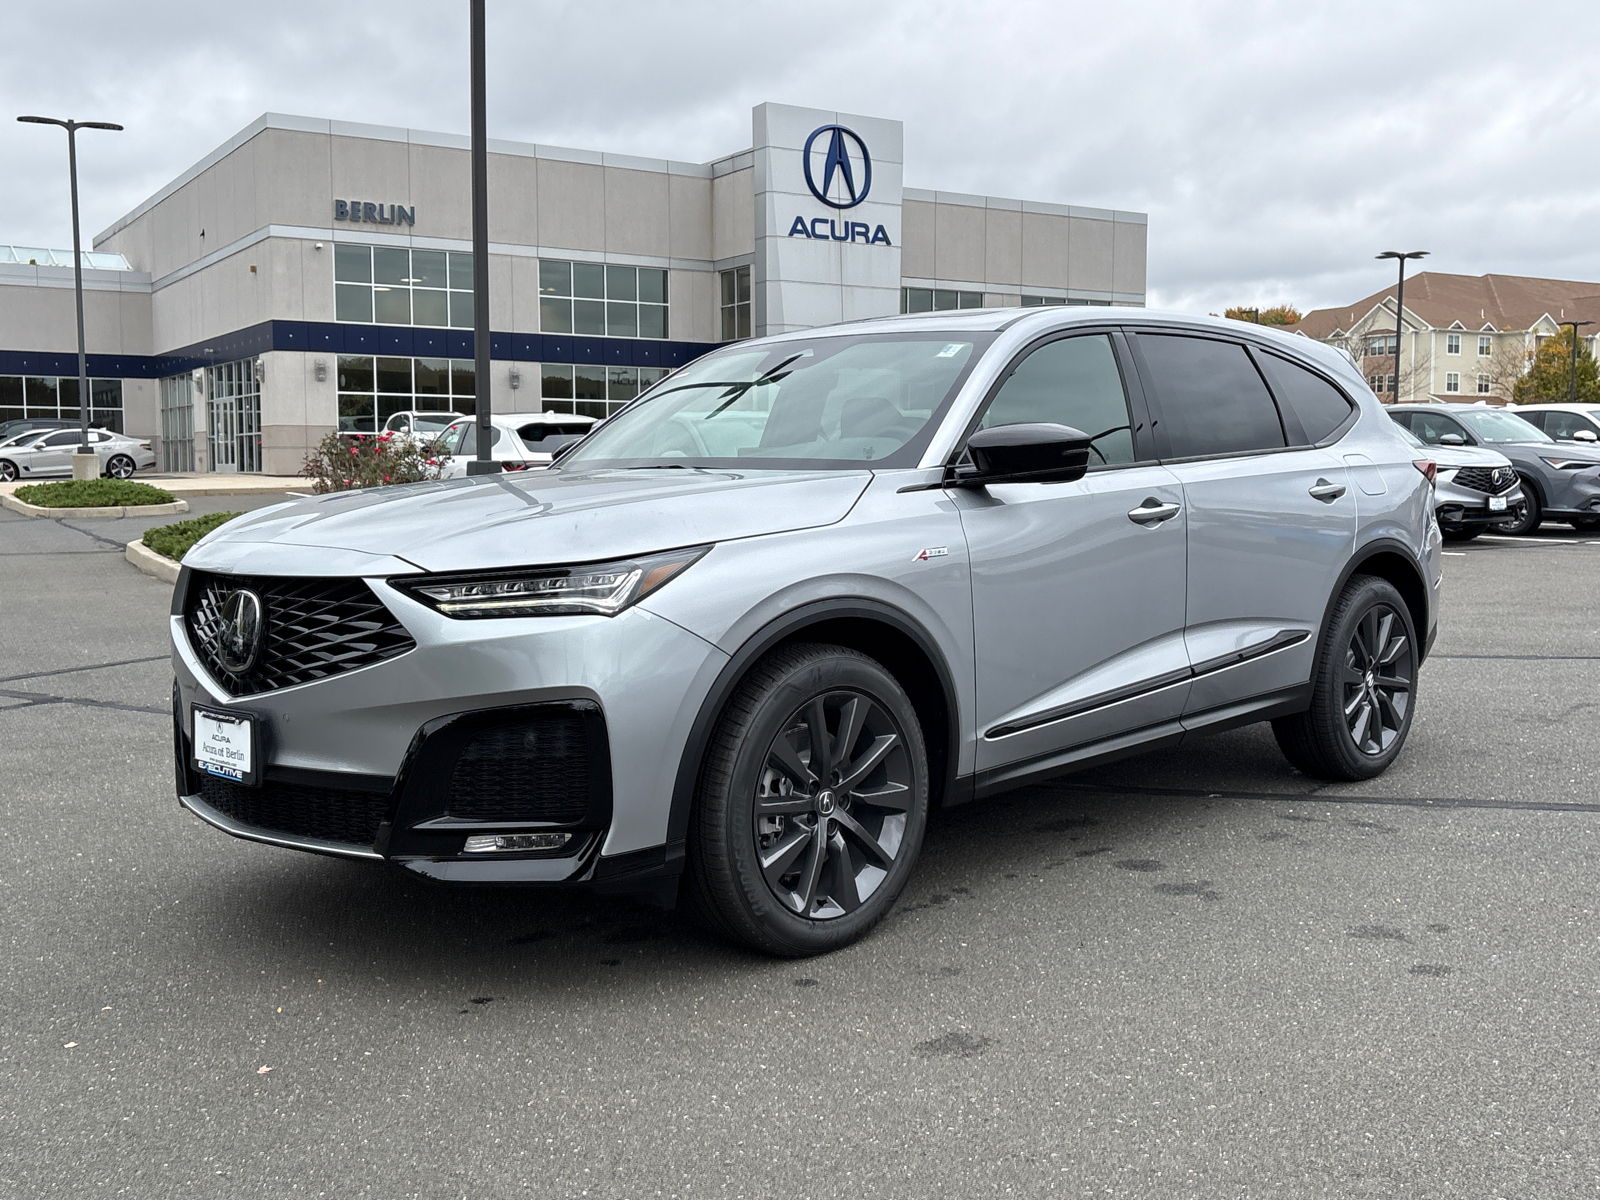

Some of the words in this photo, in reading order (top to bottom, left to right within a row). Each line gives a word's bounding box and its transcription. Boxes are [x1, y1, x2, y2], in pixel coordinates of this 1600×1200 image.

[334, 199, 415, 226] BERLIN
[788, 216, 892, 246] ACURA
[211, 734, 231, 744] ACURA
[202, 742, 217, 756] Acura
[218, 747, 224, 757] of
[225, 747, 245, 762] Berlin
[198, 761, 243, 779] EXECUTIVE
